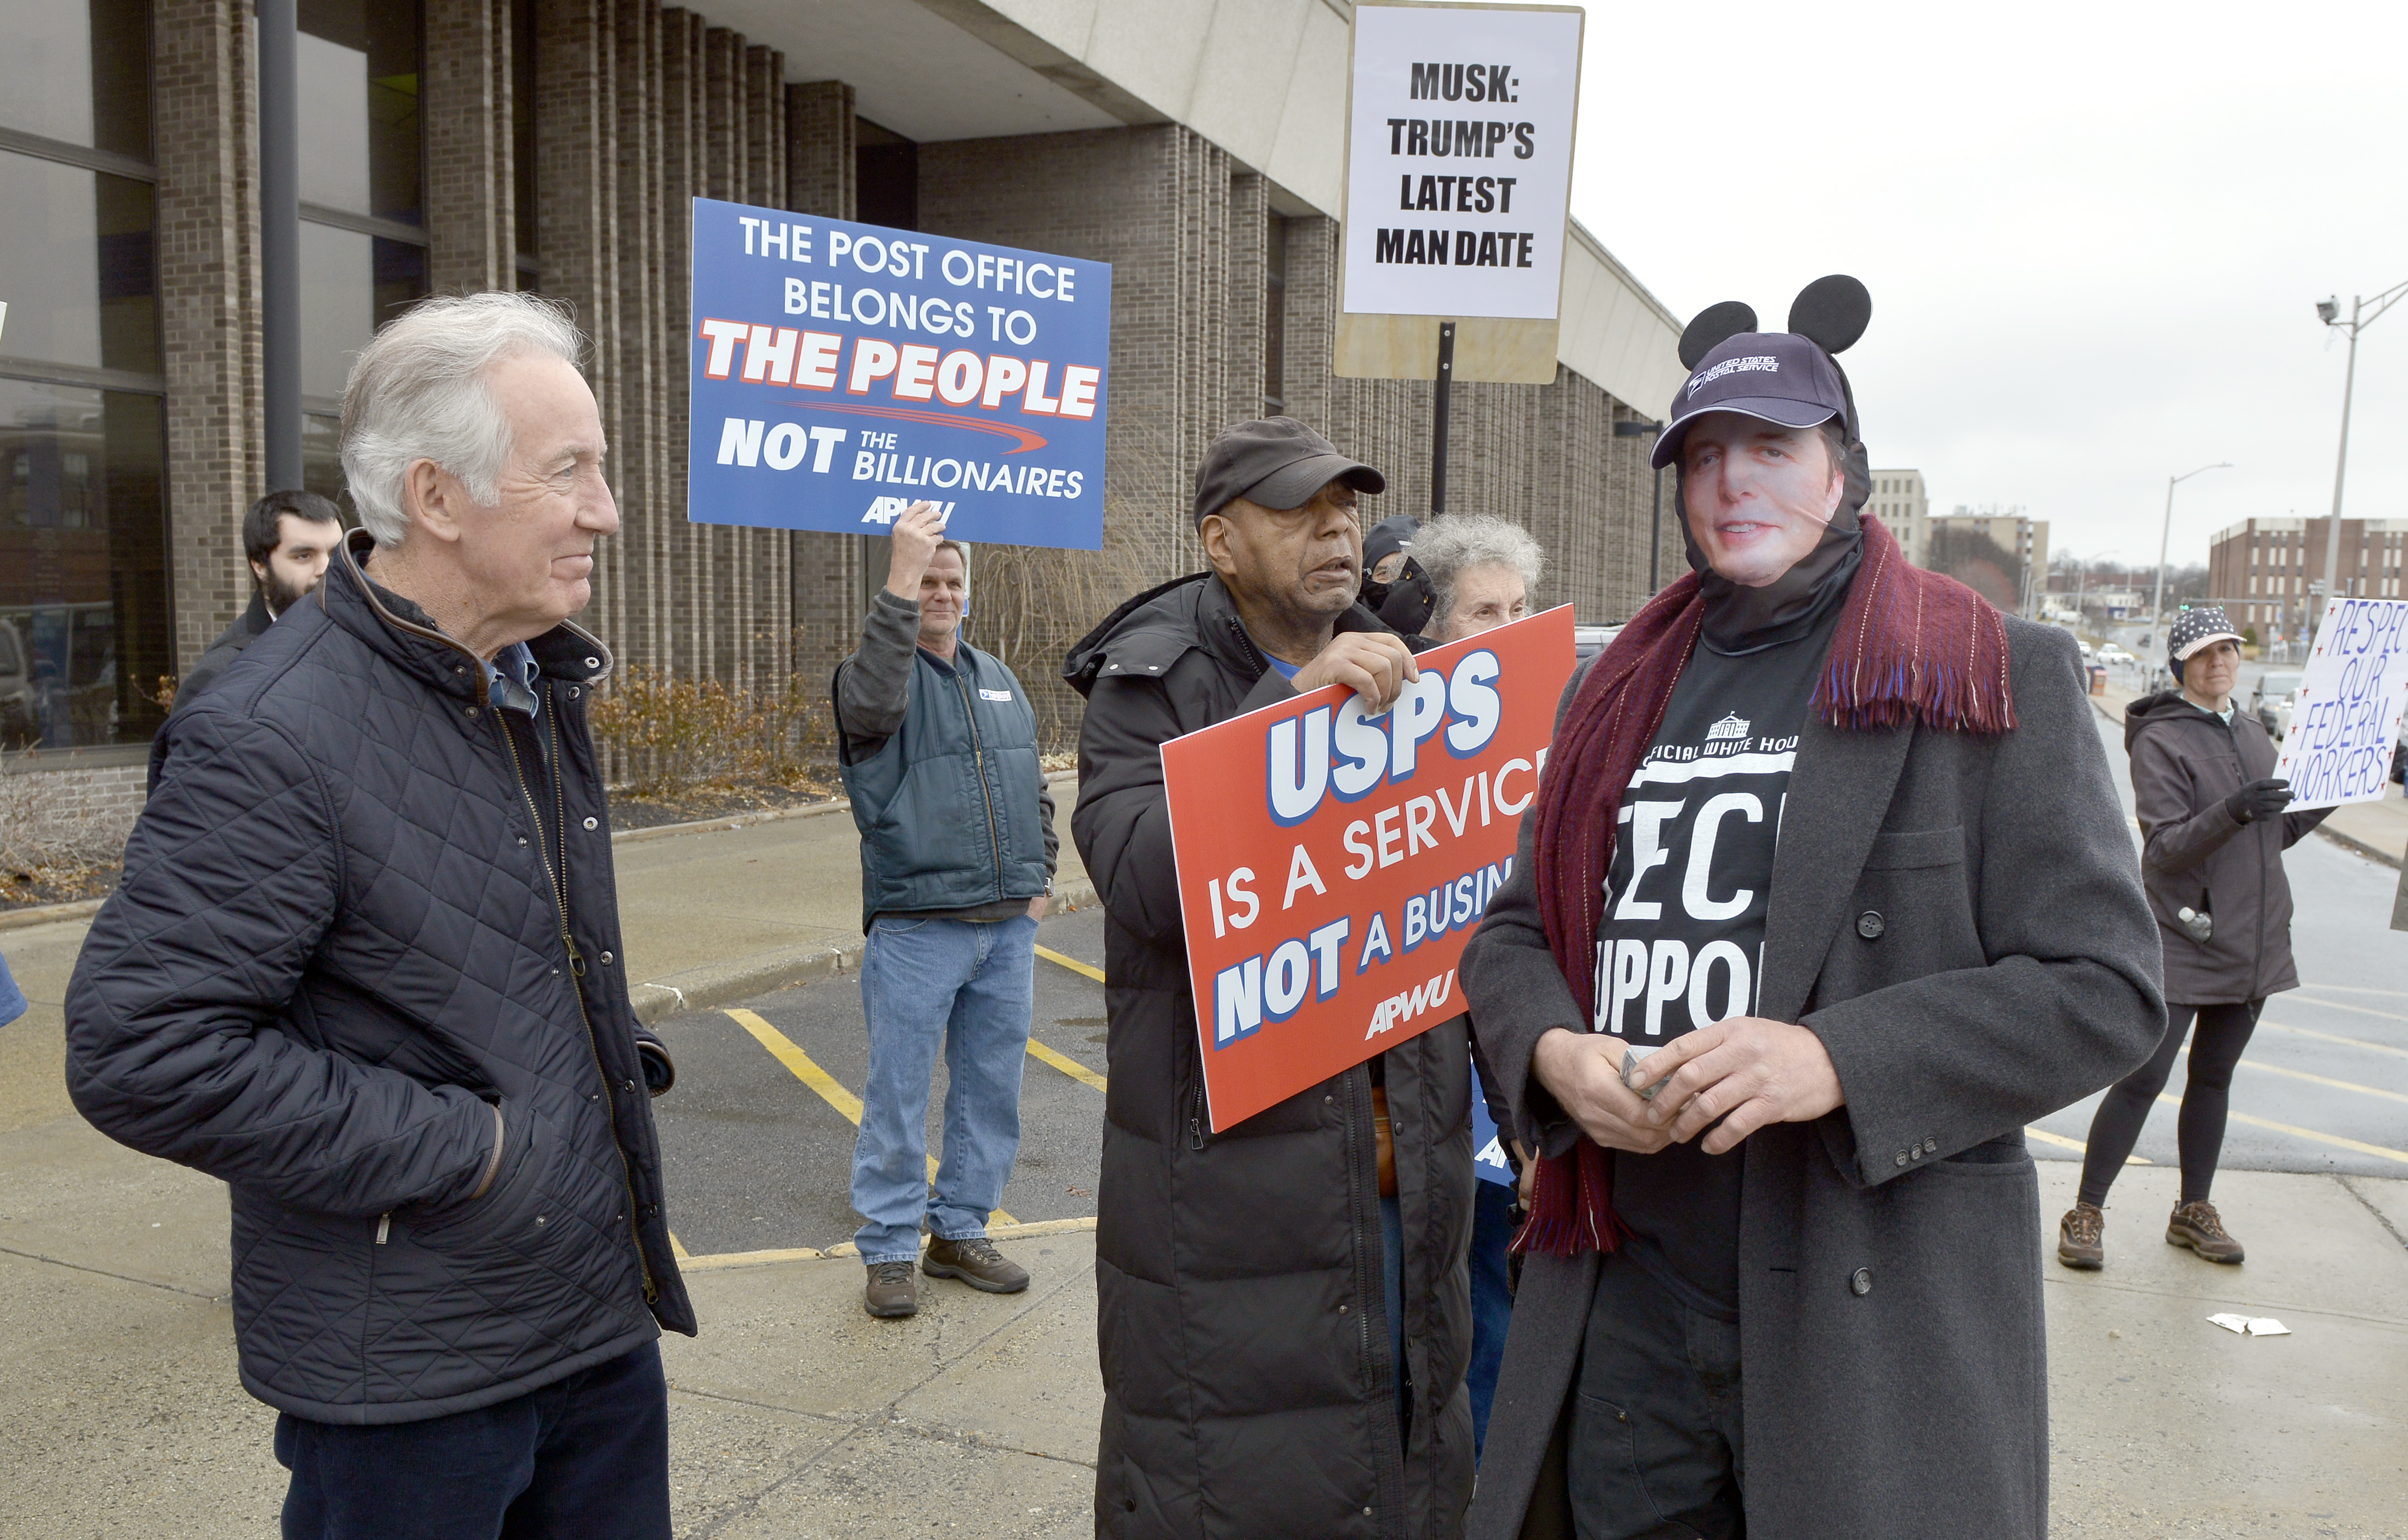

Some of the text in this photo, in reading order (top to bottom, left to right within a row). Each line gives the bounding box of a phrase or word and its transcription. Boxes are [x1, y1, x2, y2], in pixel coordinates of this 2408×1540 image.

[1410, 62, 1519, 103] MUSK:
[1387, 118, 1535, 159] TRUMP'S
[1400, 175, 1517, 213] LATEST
[739, 217, 1075, 302] THE POST OFFICE
[784, 277, 1036, 345] BELONGS TO
[699, 318, 1101, 420] THE PEOPLE
[1704, 364, 1779, 385] POSTAL SERVICE
[1707, 358, 1740, 375] UNITED
[717, 417, 898, 473] NOT THE
[852, 451, 1084, 499] BILLIONAIRES
[2328, 600, 2408, 657] RESPEC
[2339, 654, 2387, 701] OUR
[1266, 648, 1502, 827] USPS
[2300, 697, 2389, 750] FEDERAL
[1643, 744, 1699, 767] OFICIAL
[1703, 737, 1753, 755] WHITE
[2288, 746, 2386, 801] WORKERS
[1602, 792, 1787, 920] EC
[1208, 867, 1260, 939] IS
[1282, 844, 1327, 910] A
[1213, 914, 1350, 1051] NOT
[1357, 911, 1392, 979] A
[1364, 969, 1455, 1041] APWU
[1594, 939, 1765, 1035] UPPO
